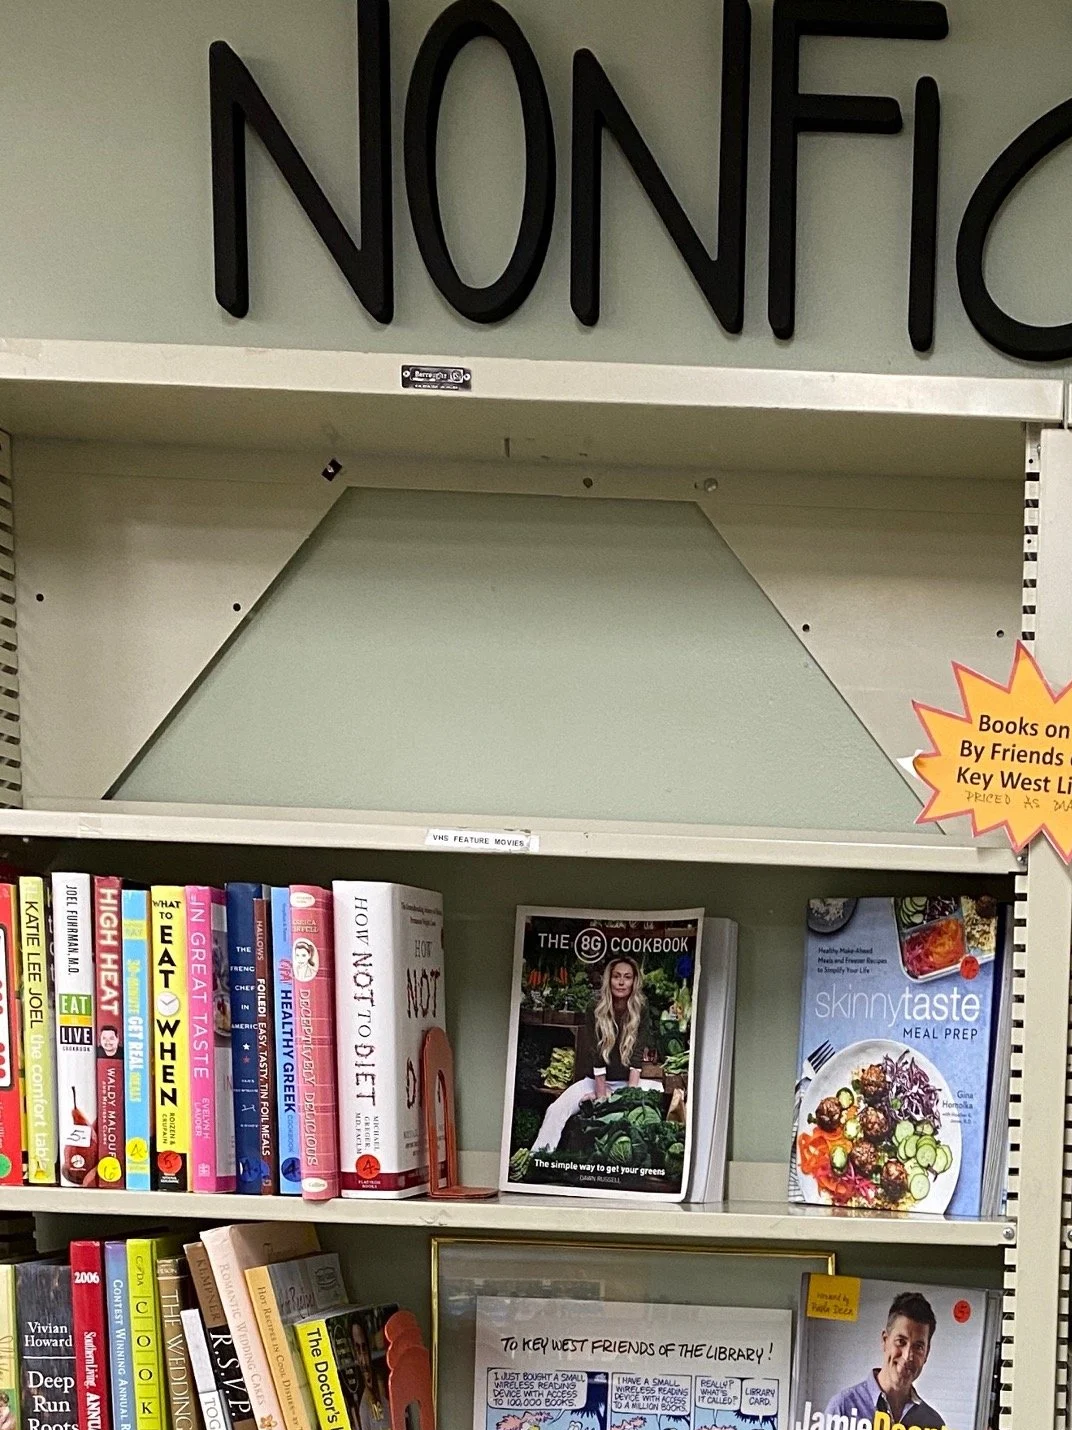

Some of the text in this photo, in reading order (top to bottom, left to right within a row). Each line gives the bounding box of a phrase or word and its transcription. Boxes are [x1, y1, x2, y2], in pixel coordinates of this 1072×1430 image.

[978, 715, 1038, 736] Books
[1045, 720, 1070, 738] on
[960, 740, 985, 762] By
[991, 743, 1064, 766] Friends
[956, 767, 993, 790] Key
[1000, 771, 1051, 793] West
[965, 791, 1011, 805] PRICED
[1024, 795, 1040, 809] AS
[454, 836, 489, 844] FEATURE
[152, 900, 180, 910] WHAT
[160, 912, 172, 920] TO
[98, 887, 119, 1015] HIGH HEAT
[538, 933, 689, 953] THE 8G COOKBOOK
[25, 901, 44, 1029] KATIE LEE JOEL
[157, 925, 177, 988] EAT
[189, 901, 209, 1079] IN GREAT TASTE
[61, 997, 89, 1014] EAT
[352, 896, 376, 1106] HOW NOT TO DIET
[815, 985, 981, 1029] skinnytaste
[61, 1027, 91, 1045] LIVE
[903, 1027, 978, 1040] MEAL PREP
[156, 1019, 181, 1106] WHEN
[534, 1159, 666, 1178] The simple way to get your greens
[74, 1271, 99, 1284] 2006
[27, 1322, 68, 1334] Vivian
[24, 1335, 72, 1348] Howard
[306, 1328, 322, 1356] The
[522, 1337, 549, 1355] KEY
[551, 1338, 589, 1355] WEST
[592, 1339, 656, 1358] FRIENDS
[659, 1342, 676, 1356] OF
[679, 1343, 706, 1359] THE
[28, 1371, 75, 1394] Deep
[33, 1396, 71, 1413] Run
